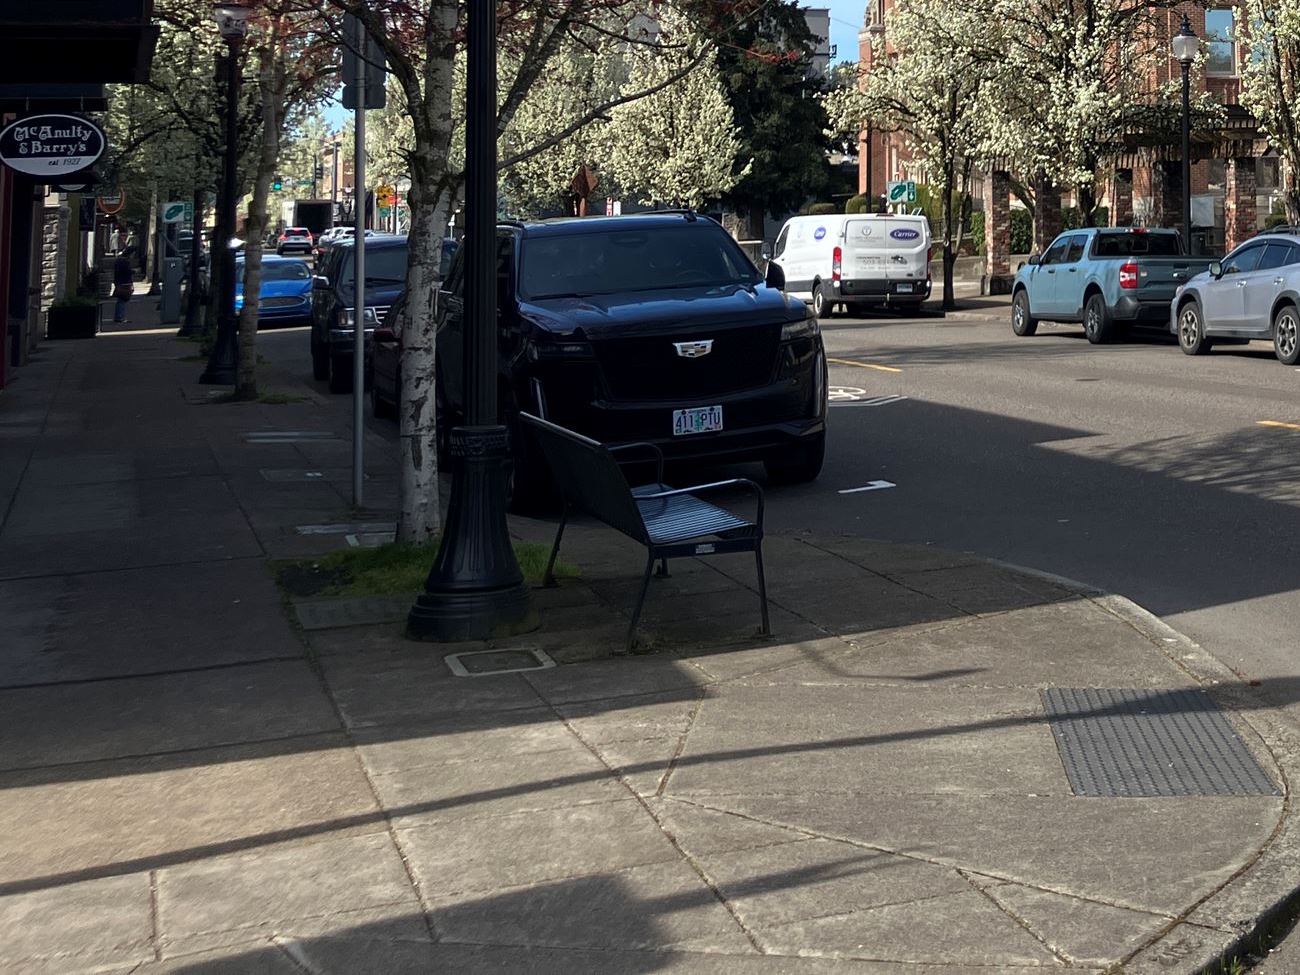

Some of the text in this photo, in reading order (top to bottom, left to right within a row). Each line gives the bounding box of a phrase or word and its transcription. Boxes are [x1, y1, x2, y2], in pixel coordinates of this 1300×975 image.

[14, 125, 92, 141] McAnulty
[31, 140, 87, 156] Barry's
[63, 157, 81, 166] 1927
[893, 228, 917, 239] Carrier
[676, 411, 721, 430] 411 PTU
